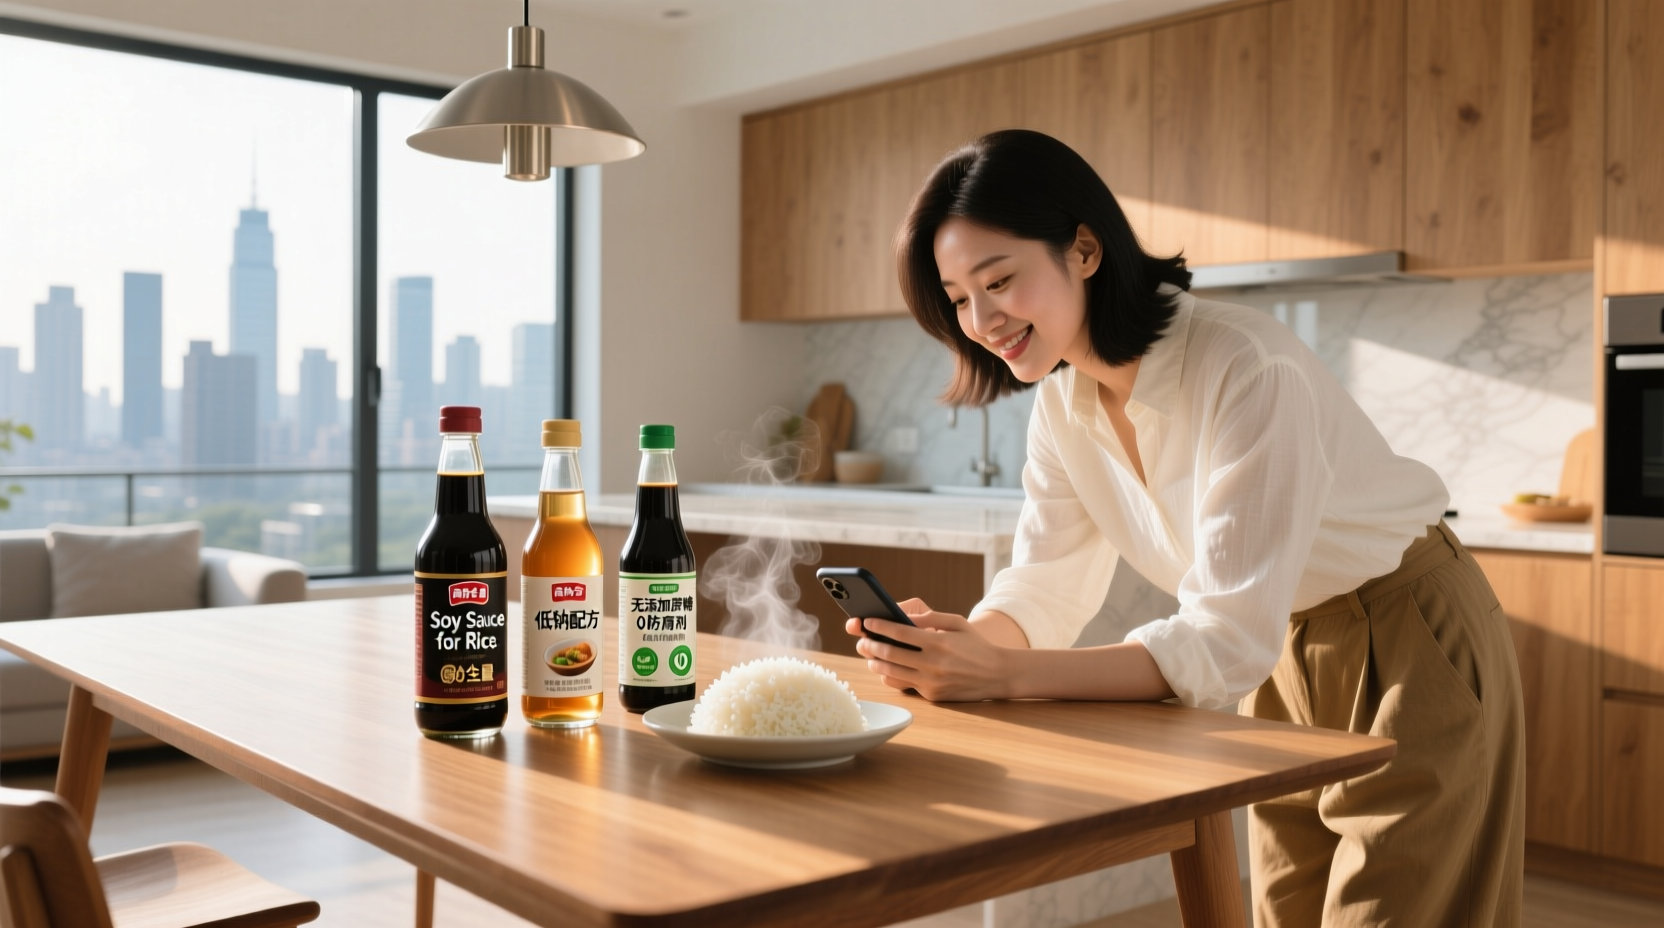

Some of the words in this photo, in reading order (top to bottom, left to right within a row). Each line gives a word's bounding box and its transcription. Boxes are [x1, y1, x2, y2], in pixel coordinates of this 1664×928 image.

[430, 611, 462, 634] Soy
[466, 611, 505, 629] Sauce
[434, 631, 462, 650] for
[466, 631, 498, 650] Rice
